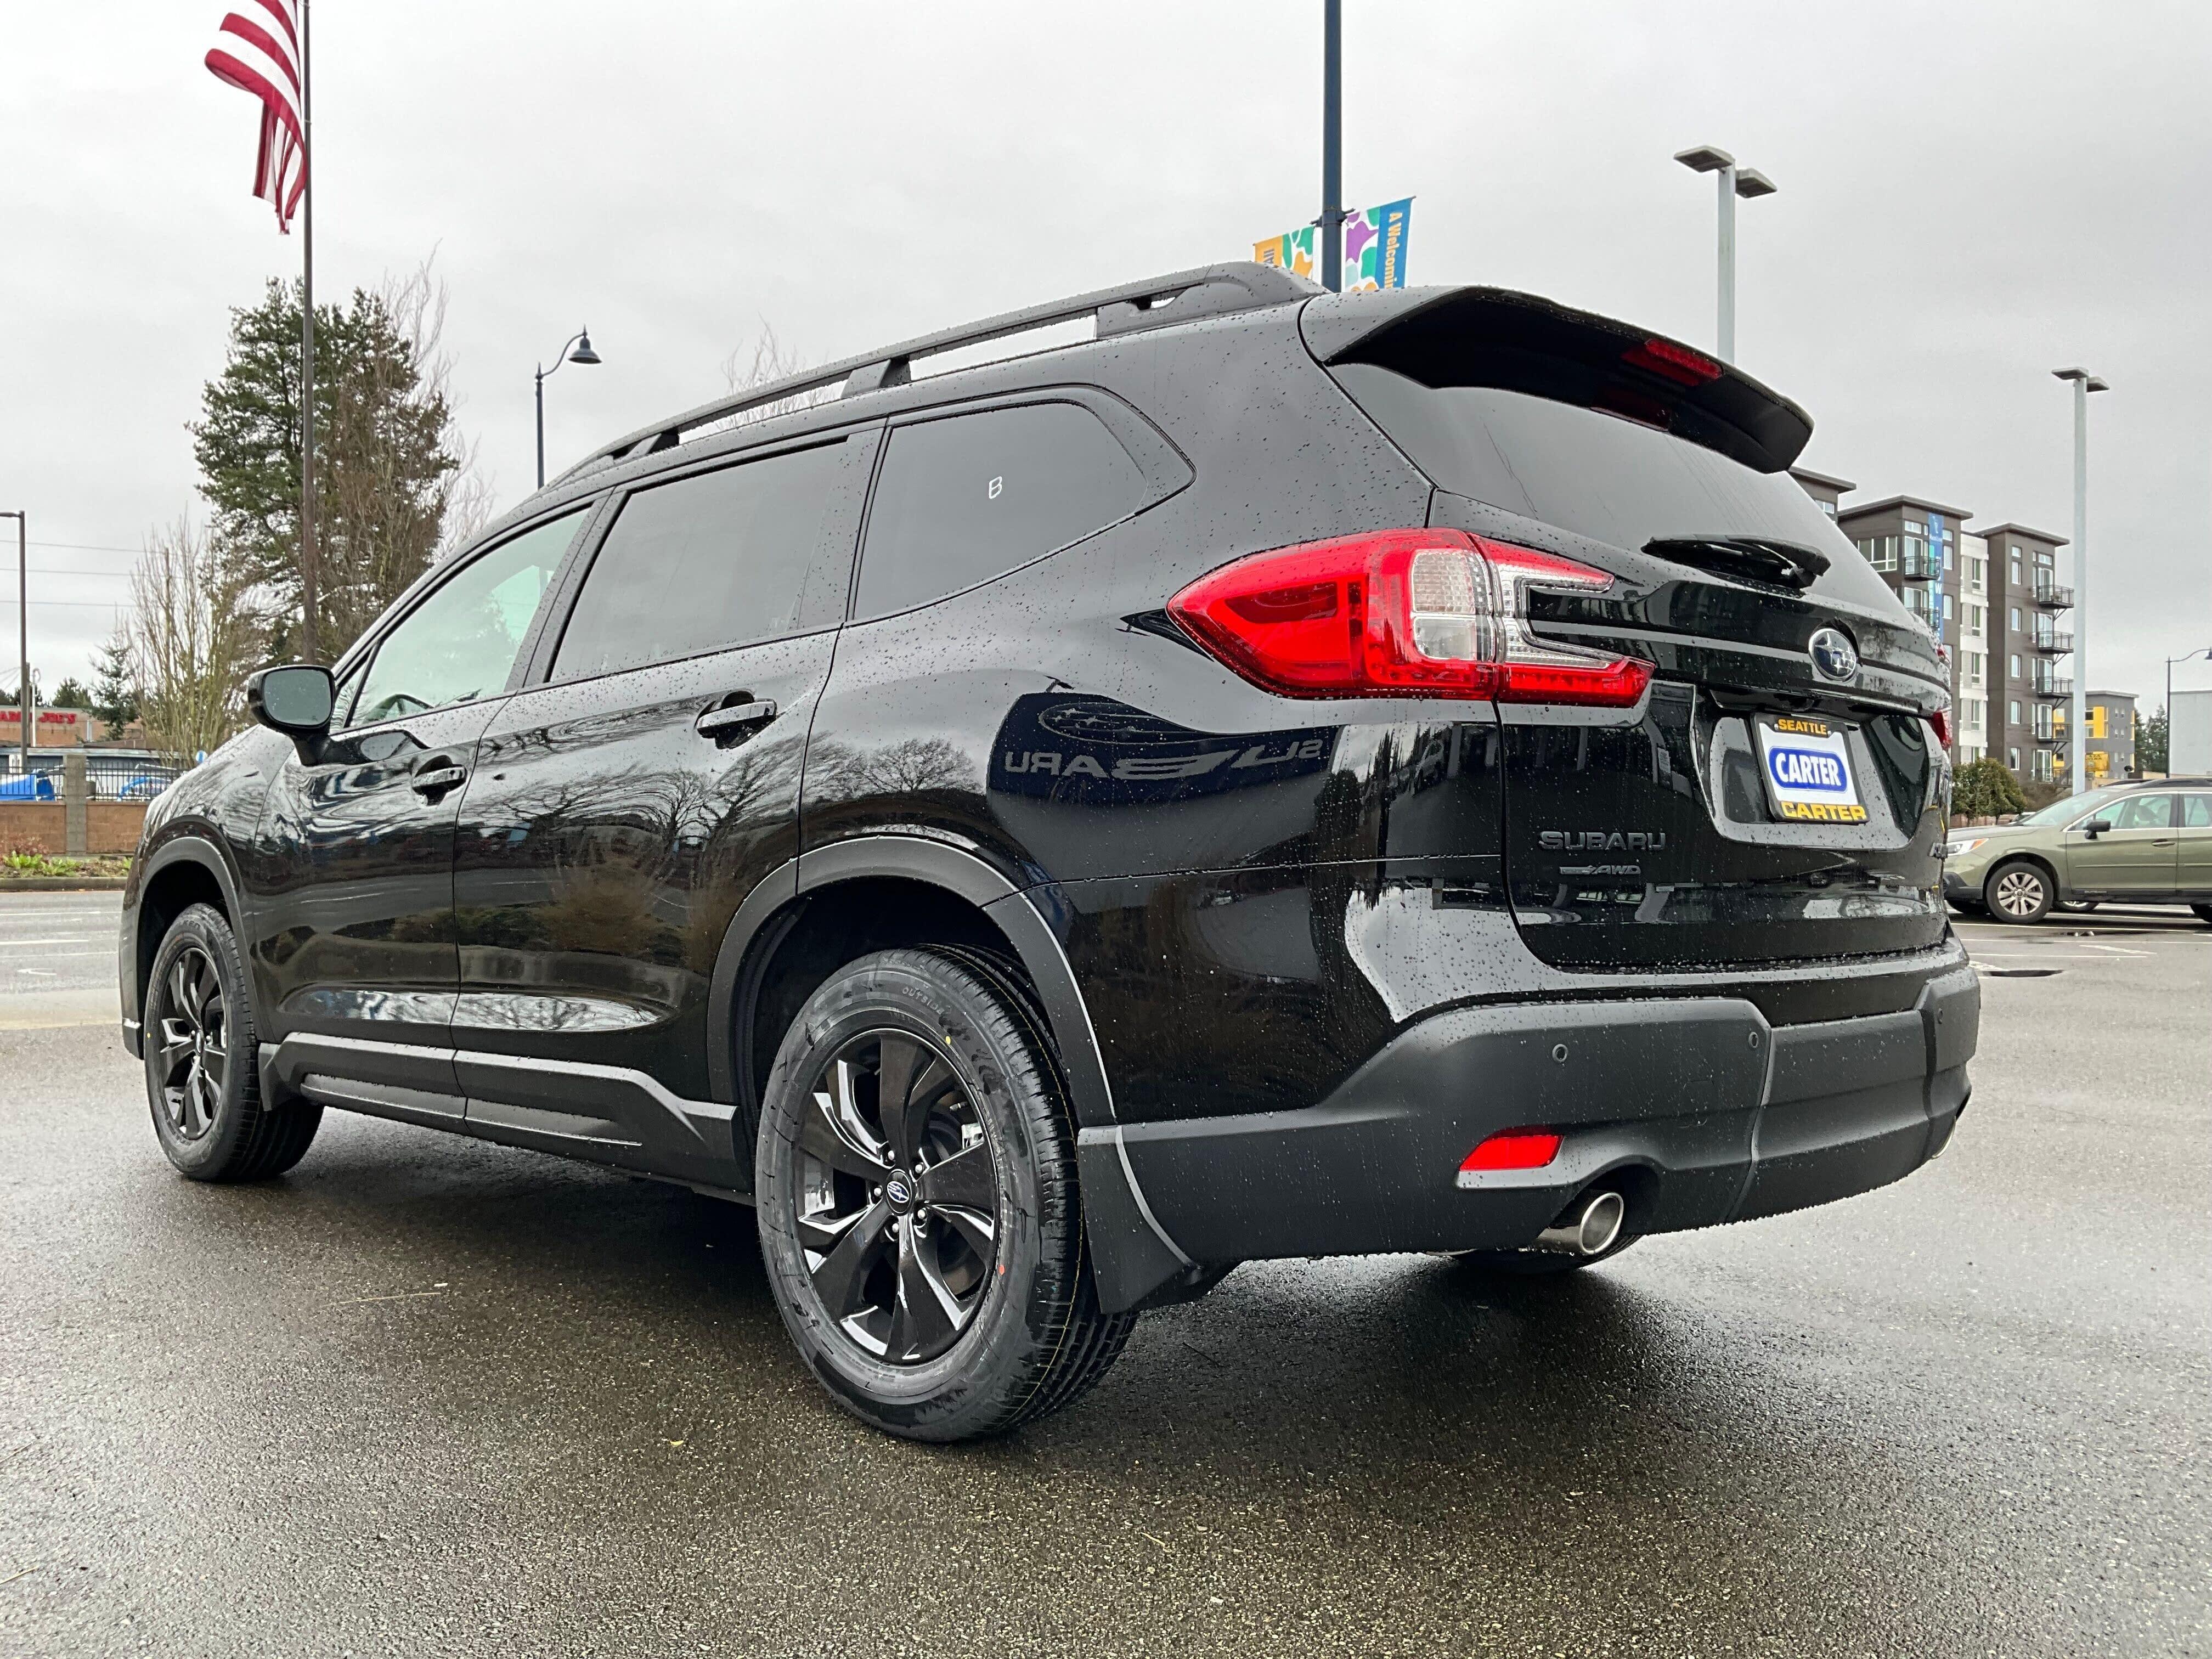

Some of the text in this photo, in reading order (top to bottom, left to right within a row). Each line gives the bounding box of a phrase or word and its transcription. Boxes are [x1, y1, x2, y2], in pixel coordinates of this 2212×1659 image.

[1389, 212, 1403, 223] A
[1778, 719, 1827, 735] SEATTLE
[1775, 752, 1842, 786] CARTER
[1781, 801, 1867, 821] CARTER
[1539, 831, 1667, 851] SUBARU
[1596, 865, 1641, 875] AWD
